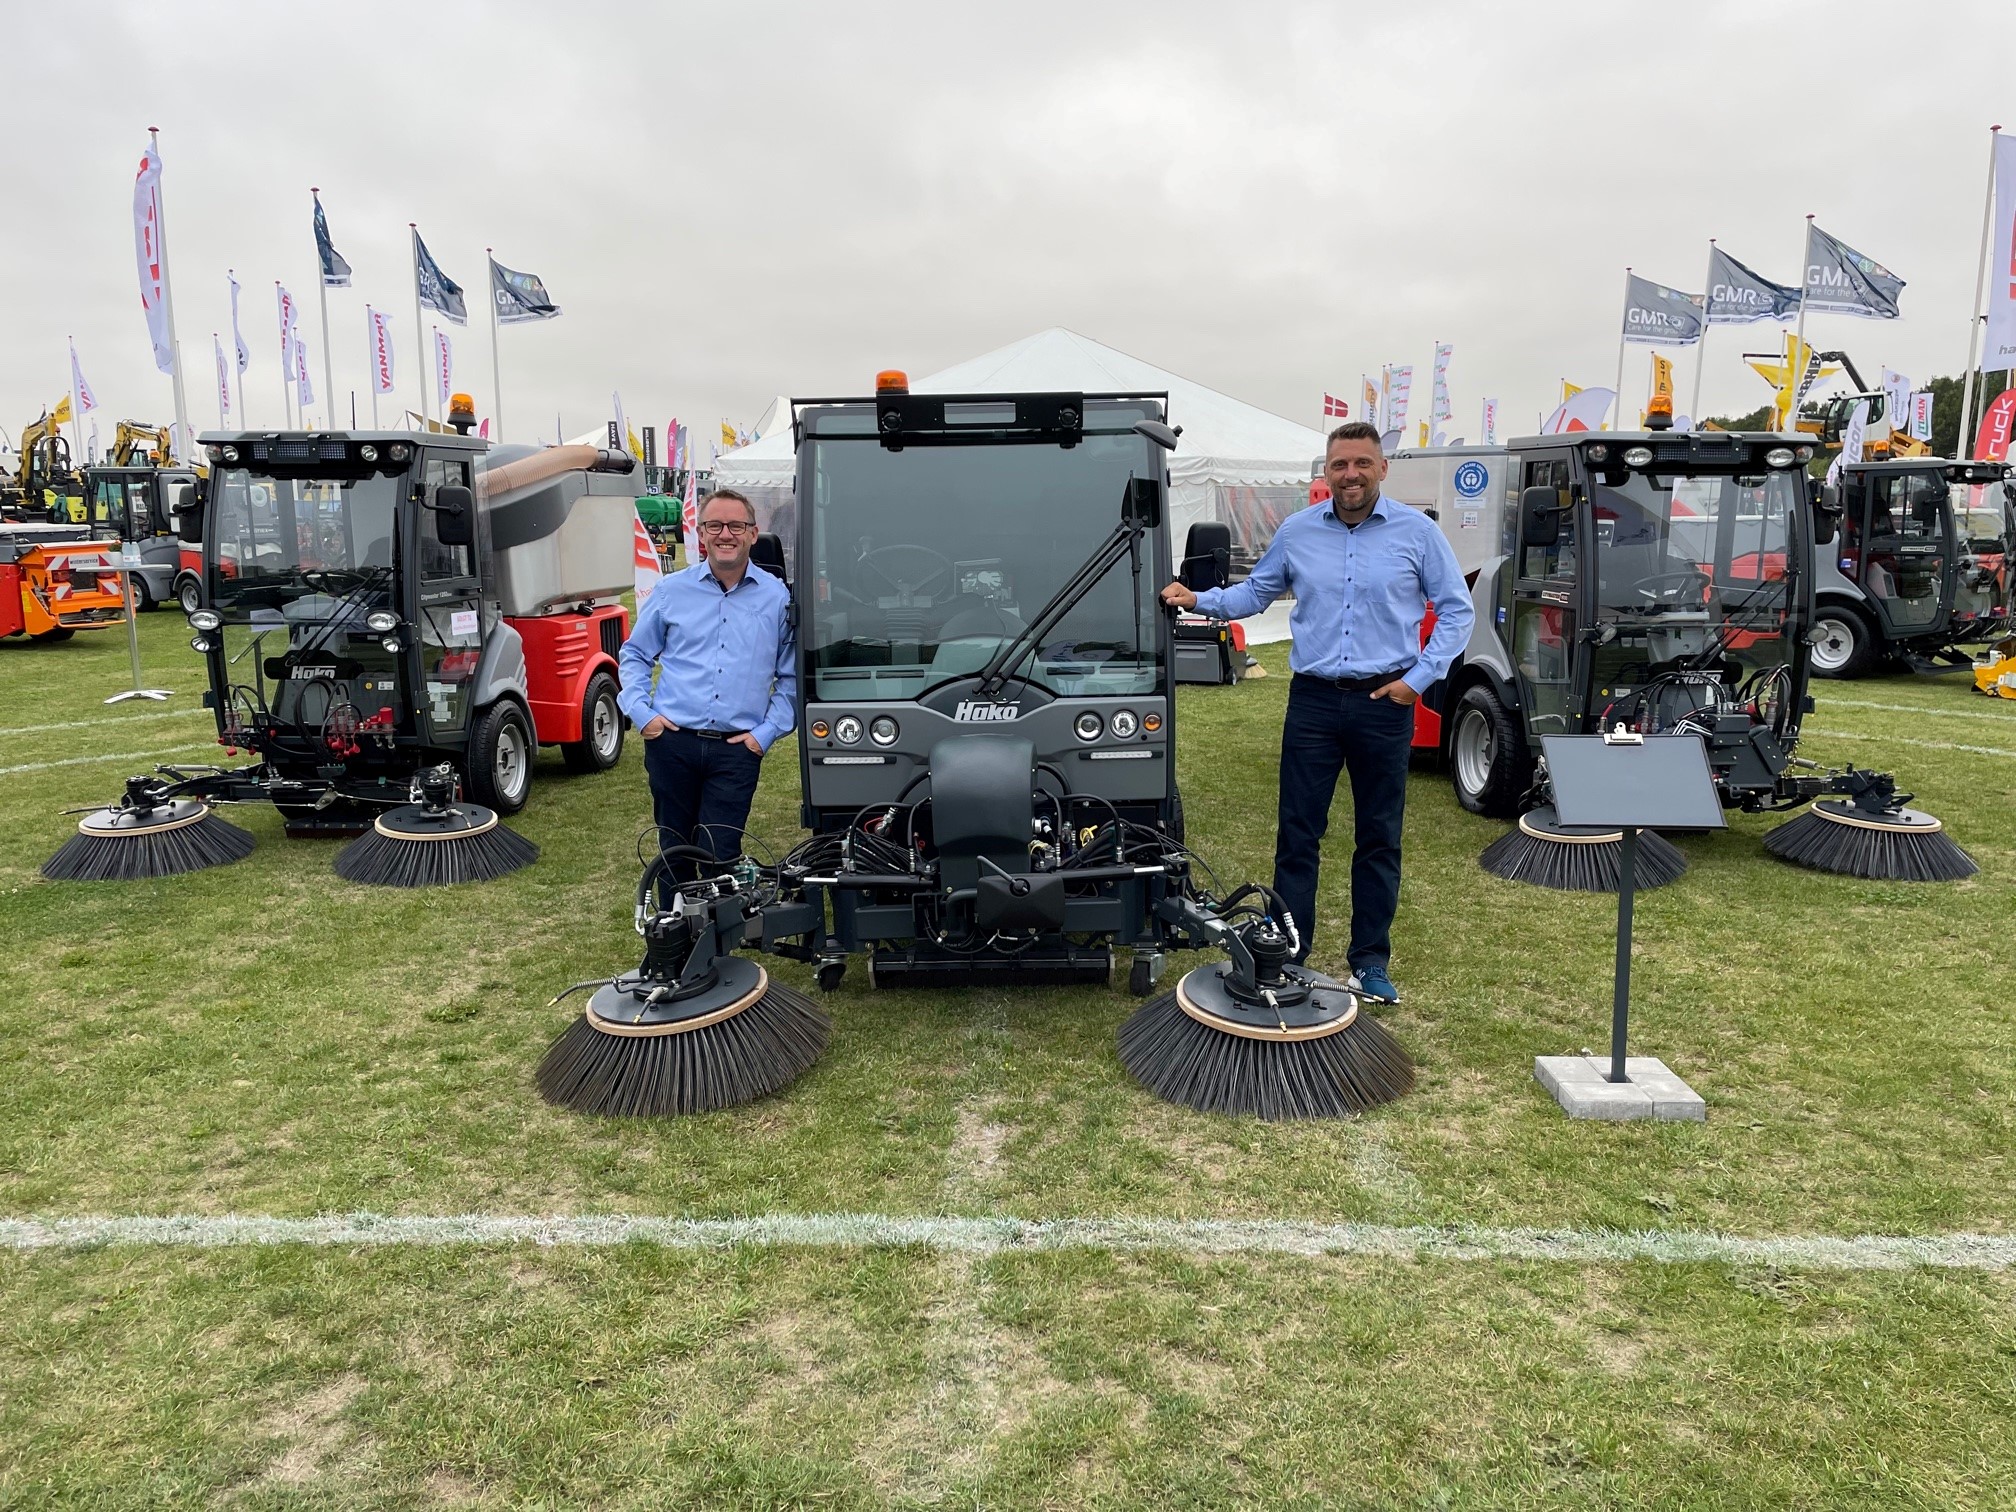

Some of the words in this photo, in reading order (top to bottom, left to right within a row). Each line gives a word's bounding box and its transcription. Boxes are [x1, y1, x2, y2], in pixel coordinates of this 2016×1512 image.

[1712, 284, 1757, 304] GMR
[1628, 307, 1669, 326] GMR
[1627, 322, 1642, 331] Care
[1652, 325, 1663, 333] the
[374, 313, 391, 389] YANMAR
[1659, 360, 1667, 396] STE
[1916, 397, 1927, 432] TIMAN
[610, 423, 618, 442] HAVE
[1988, 397, 2014, 458] ruck
[290, 666, 338, 680] Hako
[955, 701, 1020, 721] Hako
